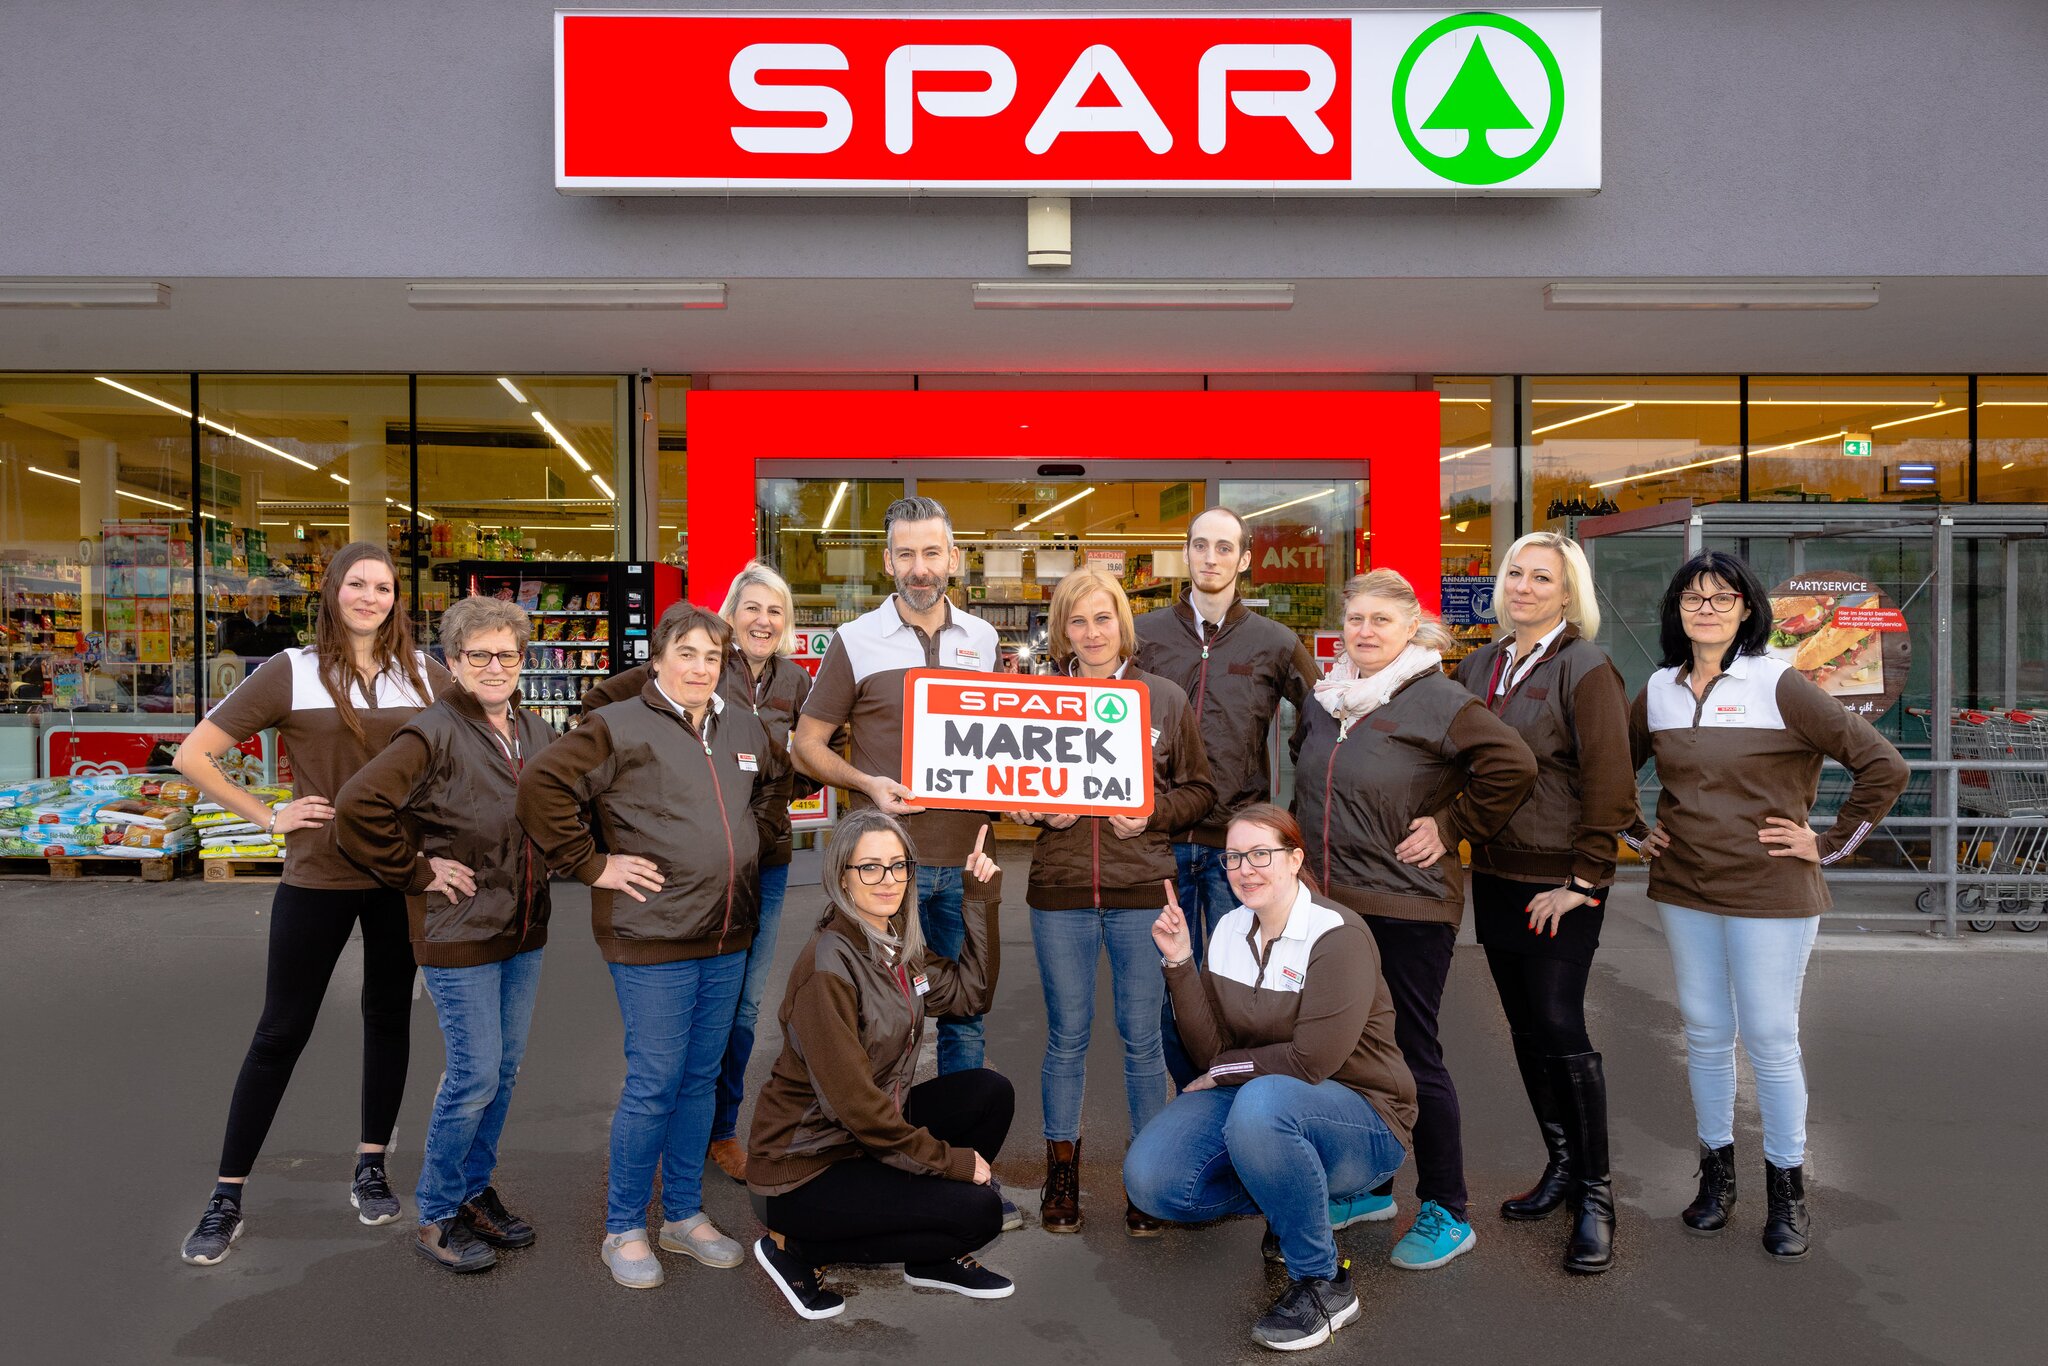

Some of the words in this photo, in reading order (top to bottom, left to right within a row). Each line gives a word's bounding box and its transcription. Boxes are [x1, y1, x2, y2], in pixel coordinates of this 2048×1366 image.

[728, 43, 1337, 155] SPAR
[1087, 551, 1124, 559] AKTION!
[1261, 546, 1323, 569] AKTI
[1107, 563, 1122, 571] 19,60
[1790, 581, 1867, 592] PARTYSERVICE
[959, 691, 1083, 716] SPAR
[1859, 701, 1873, 715] gibt
[944, 720, 1117, 765] MAREK
[926, 767, 974, 794] IST
[986, 764, 1068, 798] NEU
[1083, 776, 1131, 801] DA!
[795, 801, 816, 809] -41%
